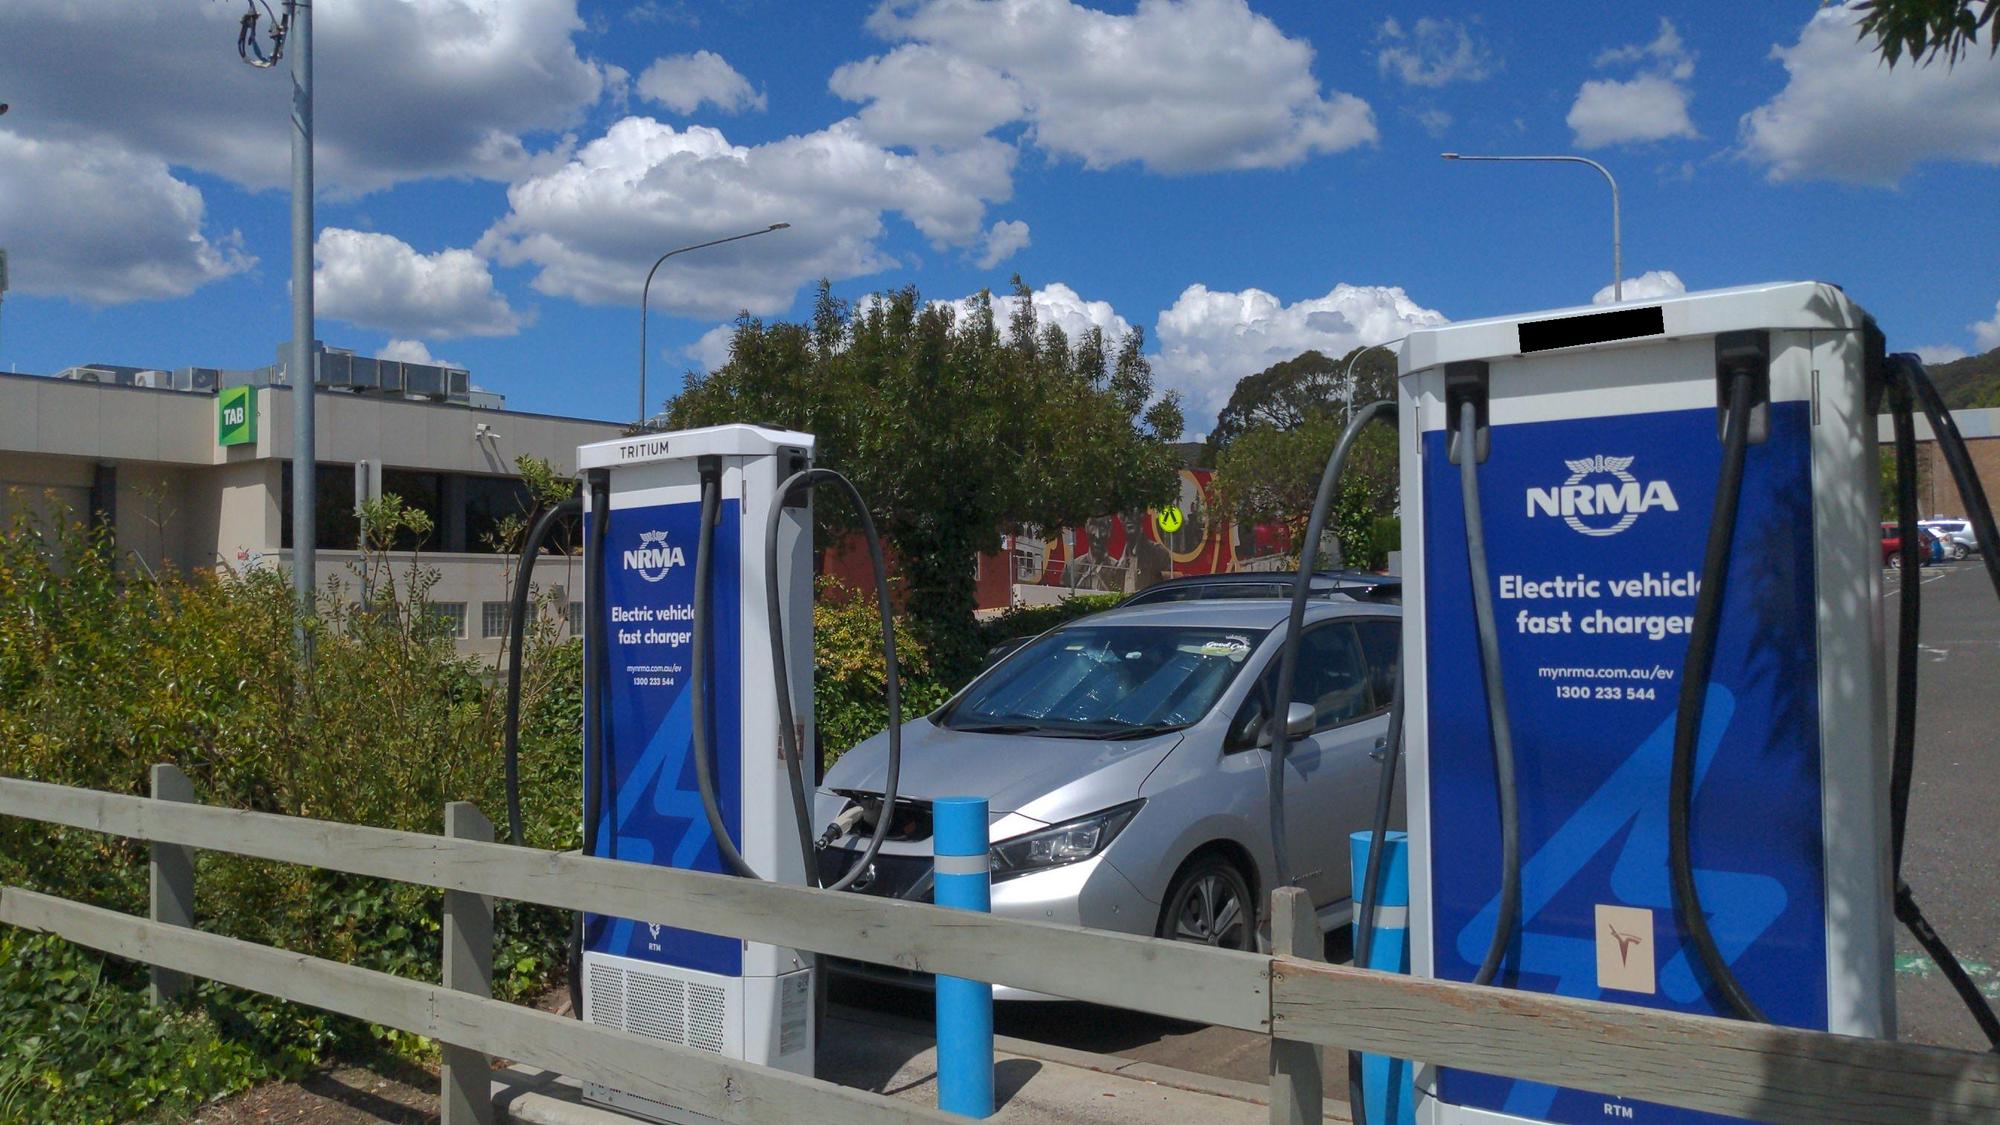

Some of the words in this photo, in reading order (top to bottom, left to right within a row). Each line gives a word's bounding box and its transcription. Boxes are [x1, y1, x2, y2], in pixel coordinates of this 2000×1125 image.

[223, 407, 244, 426] TAB
[620, 441, 669, 459] TRITIUM
[1526, 480, 1680, 518] NRMA
[623, 547, 686, 570] NRMA
[1499, 574, 1600, 599] Electric
[1608, 571, 1701, 598] vehicl
[611, 605, 653, 622] Electric
[1516, 609, 1572, 634] fast
[1580, 608, 1695, 640] charger
[618, 628, 642, 645] fast
[644, 628, 692, 648] charger
[626, 663, 682, 674] mynrma.com.au/ev
[1538, 665, 1674, 681] mynrma.com.au/ev
[633, 677, 648, 686] 1300
[649, 677, 661, 686] 233
[662, 677, 674, 686] 544
[1556, 686, 1590, 699] 1300
[1595, 687, 1622, 700] 233
[1626, 687, 1656, 701] 544
[1603, 1103, 1633, 1119] RTM
